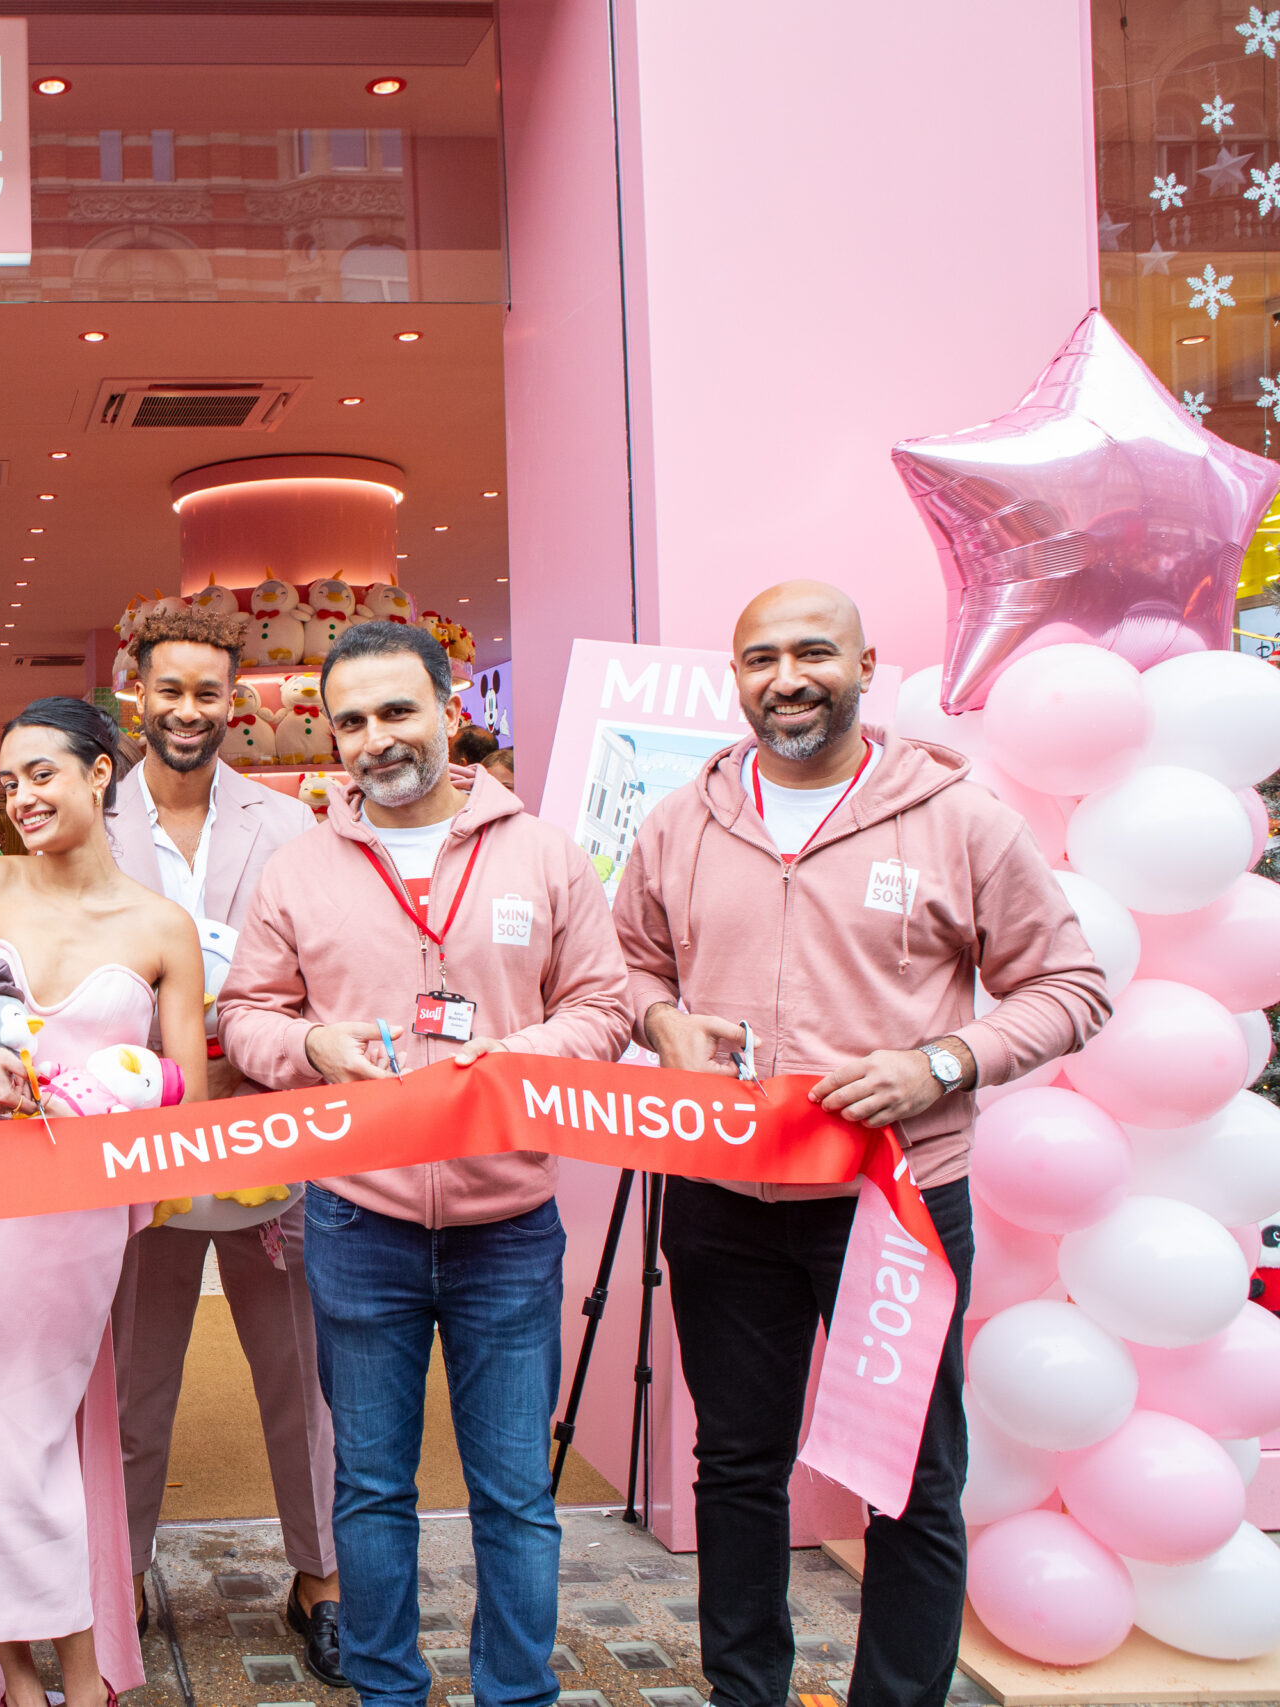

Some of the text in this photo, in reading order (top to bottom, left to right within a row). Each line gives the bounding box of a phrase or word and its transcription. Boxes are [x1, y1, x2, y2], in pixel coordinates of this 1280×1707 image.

[599, 658, 748, 723] MIN
[874, 871, 913, 890] MINI
[871, 887, 894, 903] SO
[497, 907, 529, 922] MINI
[497, 923, 515, 937] SO
[419, 1006, 443, 1021] Staff
[522, 1077, 706, 1142] MINISO
[102, 1112, 299, 1179] MINISO
